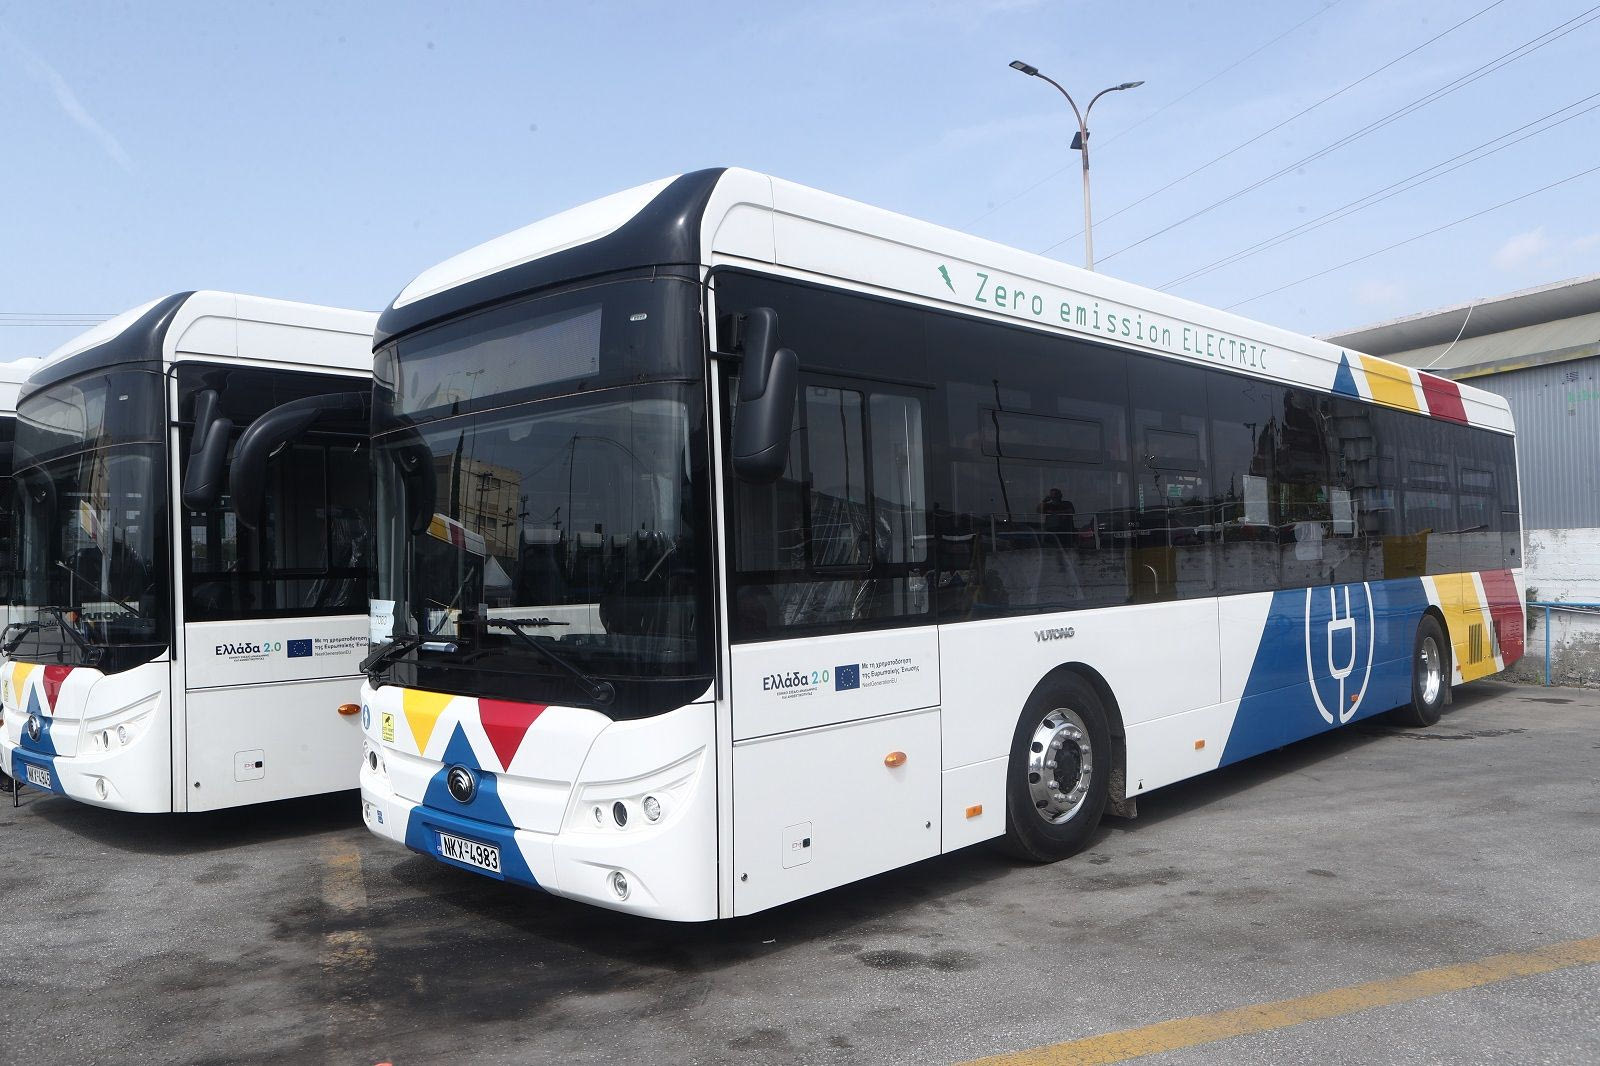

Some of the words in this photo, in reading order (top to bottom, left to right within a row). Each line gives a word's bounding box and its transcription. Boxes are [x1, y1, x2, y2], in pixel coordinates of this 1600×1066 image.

[975, 272, 1043, 316] Zero
[1060, 302, 1171, 347] emission
[1183, 327, 1267, 370] ELECTRIC
[1034, 626, 1076, 642] YUTONG
[215, 642, 261, 656] Ελλάδα
[263, 641, 282, 653] 2.0
[763, 671, 809, 691] Ελλάδα
[811, 669, 830, 685] 2.0
[444, 836, 498, 870] NKX-4983
